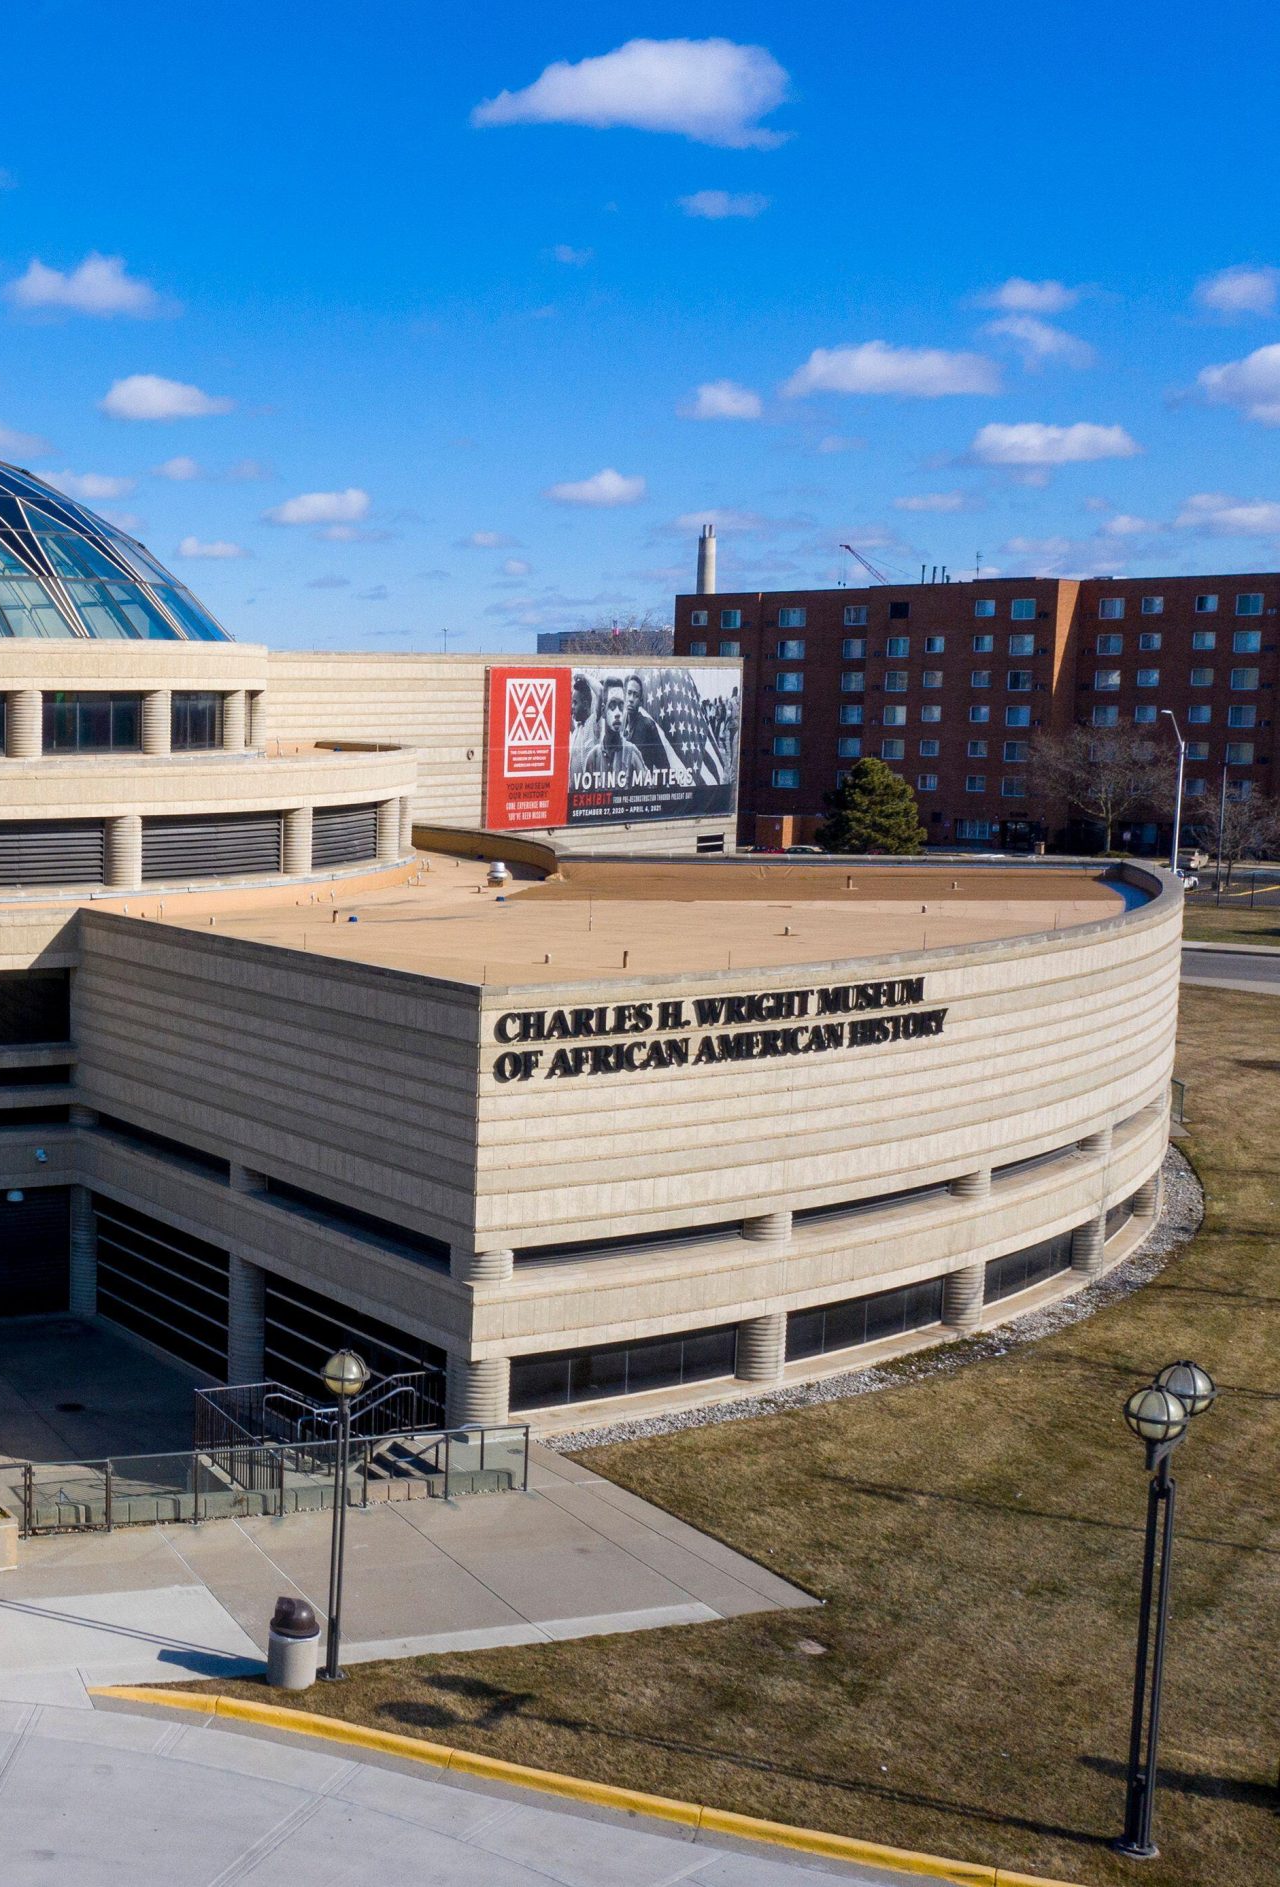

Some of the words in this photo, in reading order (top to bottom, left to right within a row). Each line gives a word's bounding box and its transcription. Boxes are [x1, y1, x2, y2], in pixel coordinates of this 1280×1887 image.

[524, 782, 551, 790] MUSEUM
[573, 770, 627, 790] VOTING
[631, 767, 693, 787] MATTERS
[508, 792, 521, 800] OUR
[522, 791, 548, 799] HISTORY
[572, 792, 613, 807] EXHIBIT
[572, 808, 603, 817] SEPTEMBER
[612, 806, 625, 815] 2020
[629, 805, 645, 813] APRIL
[650, 804, 662, 812] 2021
[493, 1002, 653, 1044] CHARLES
[657, 1000, 691, 1031] H.
[691, 989, 816, 1025] WRIGHT
[816, 977, 926, 1017] MUSEUM
[492, 1050, 544, 1084] OF
[545, 1037, 690, 1079] AFRICAN
[691, 1021, 845, 1065] AMERICAN
[846, 1008, 949, 1049] HISTORY
